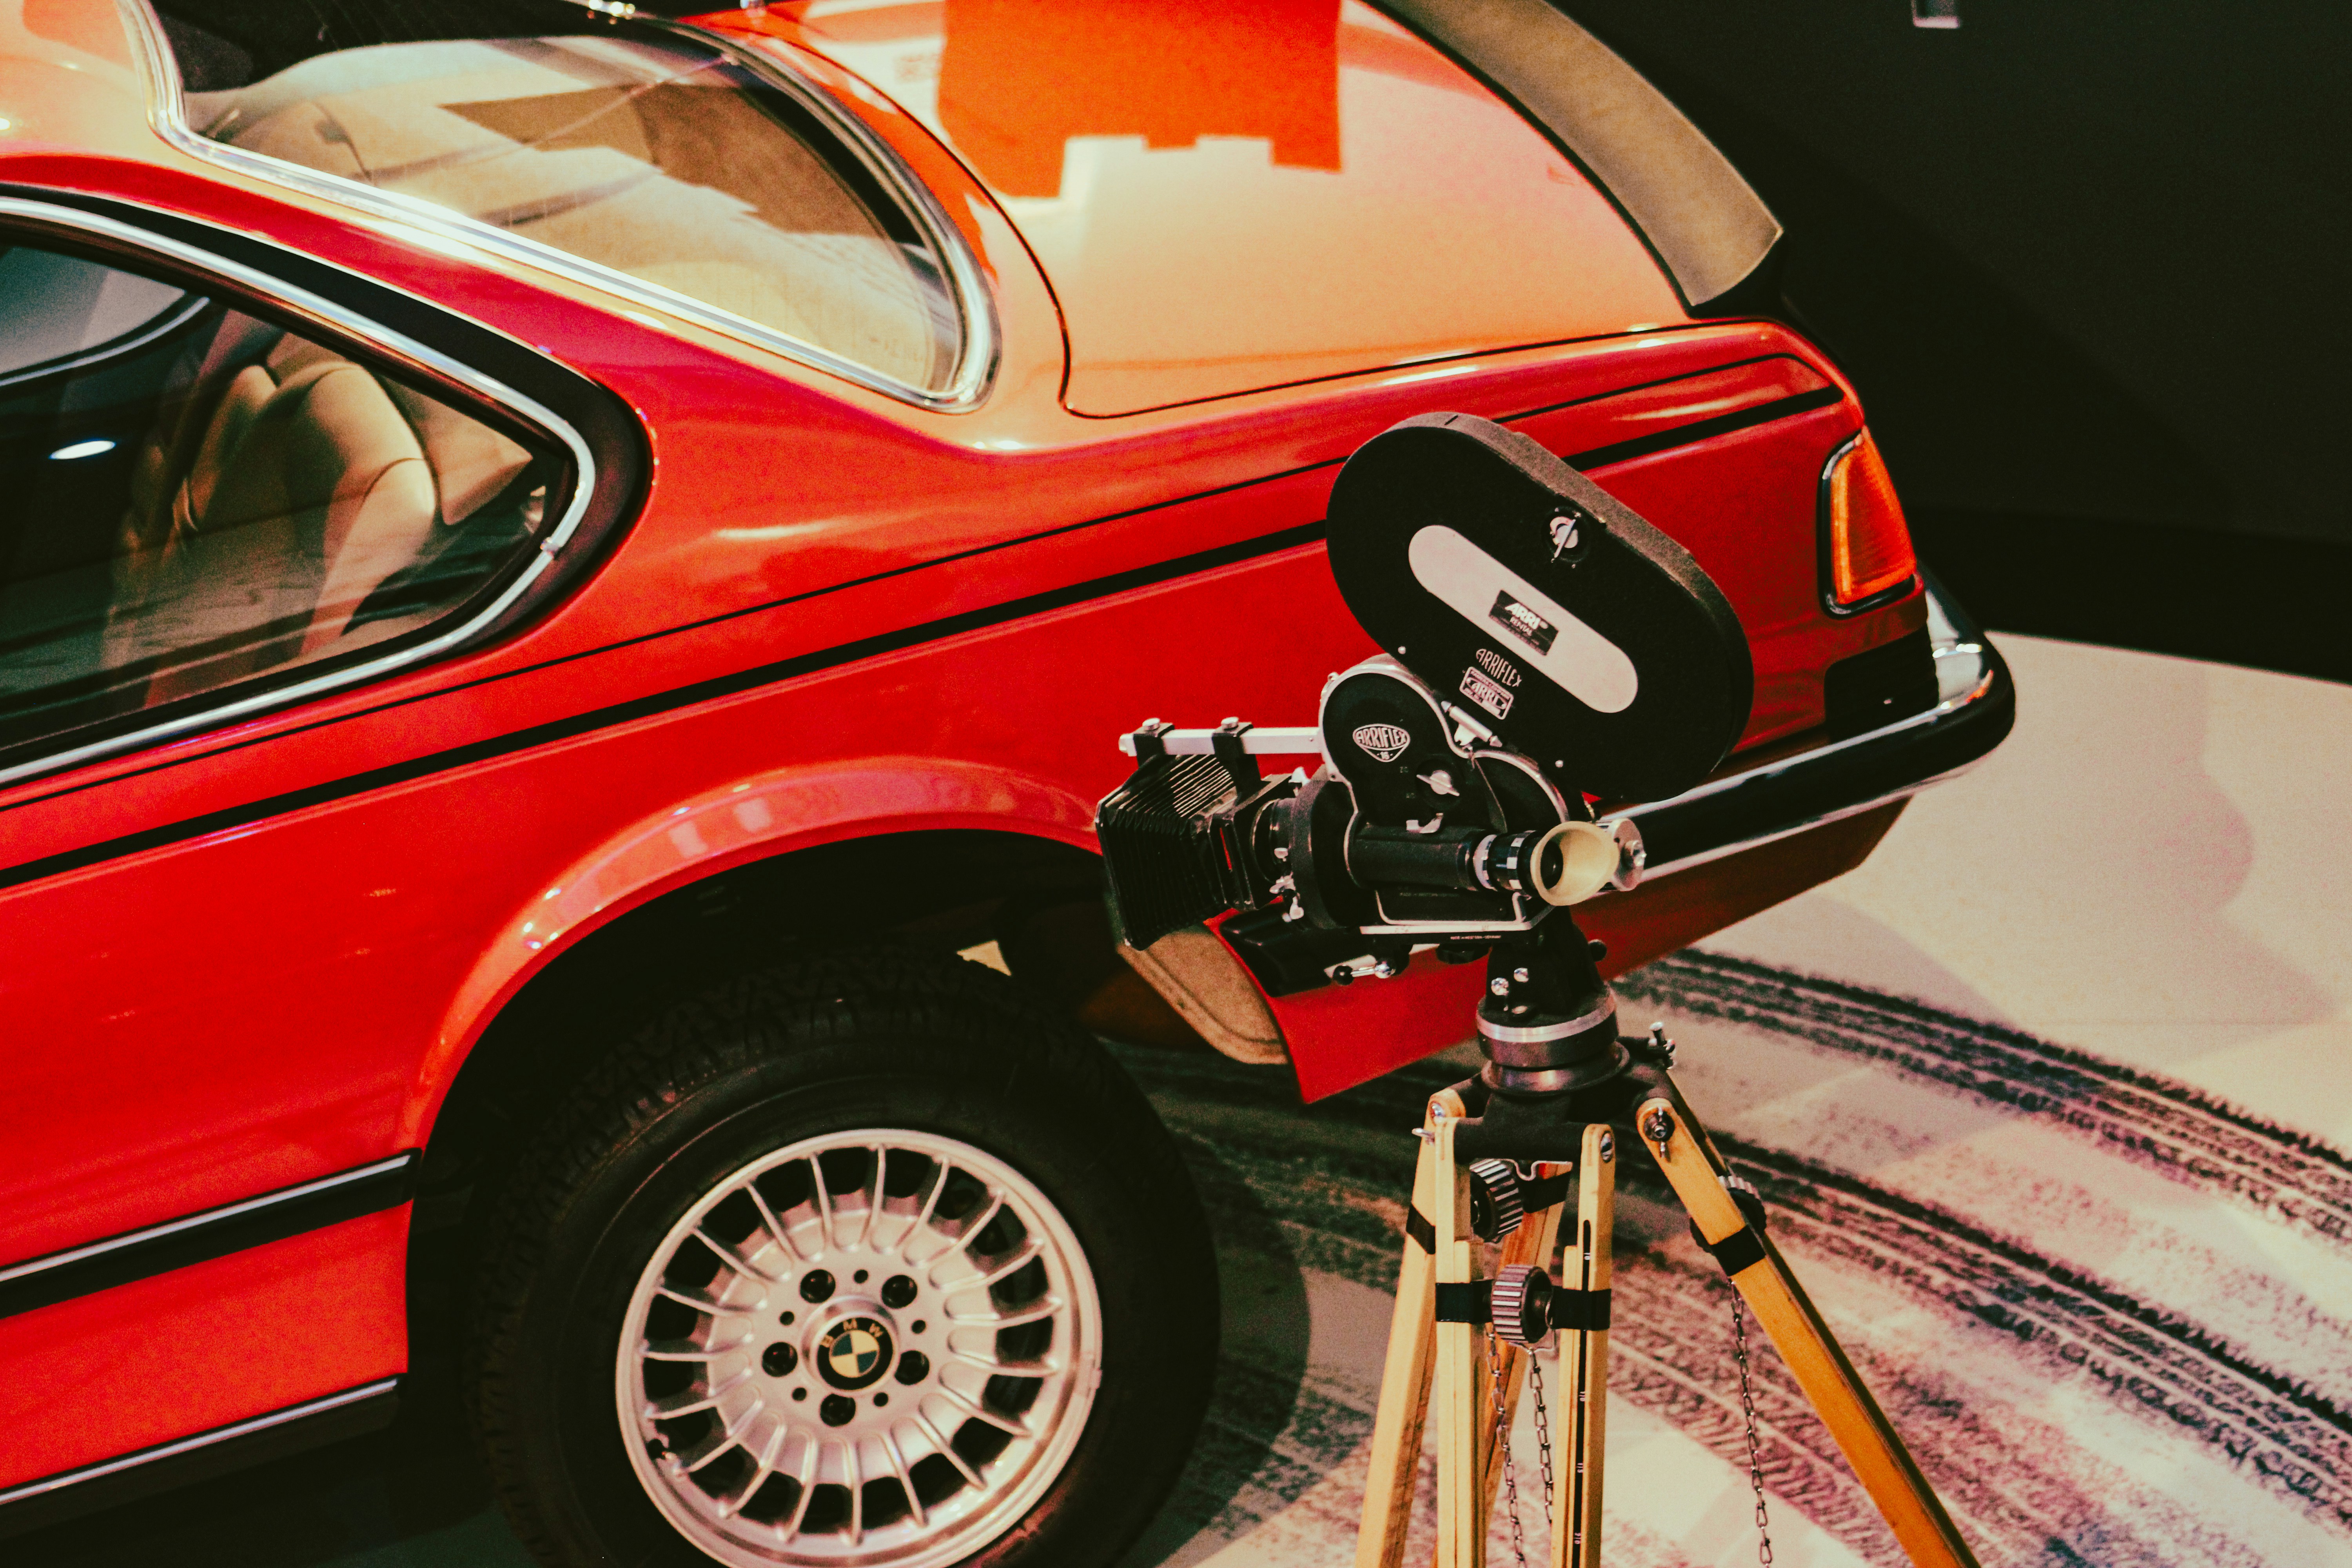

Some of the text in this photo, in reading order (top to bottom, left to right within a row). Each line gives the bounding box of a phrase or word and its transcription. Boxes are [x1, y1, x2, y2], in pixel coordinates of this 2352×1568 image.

[1504, 603, 1541, 630] ARRI
[1510, 616, 1532, 637] RENTAL
[1475, 648, 1522, 687] ARRIFLEX
[1471, 682, 1500, 706] ARRI
[1356, 727, 1406, 748] ARRIFLEX
[819, 1318, 884, 1348] BMW
